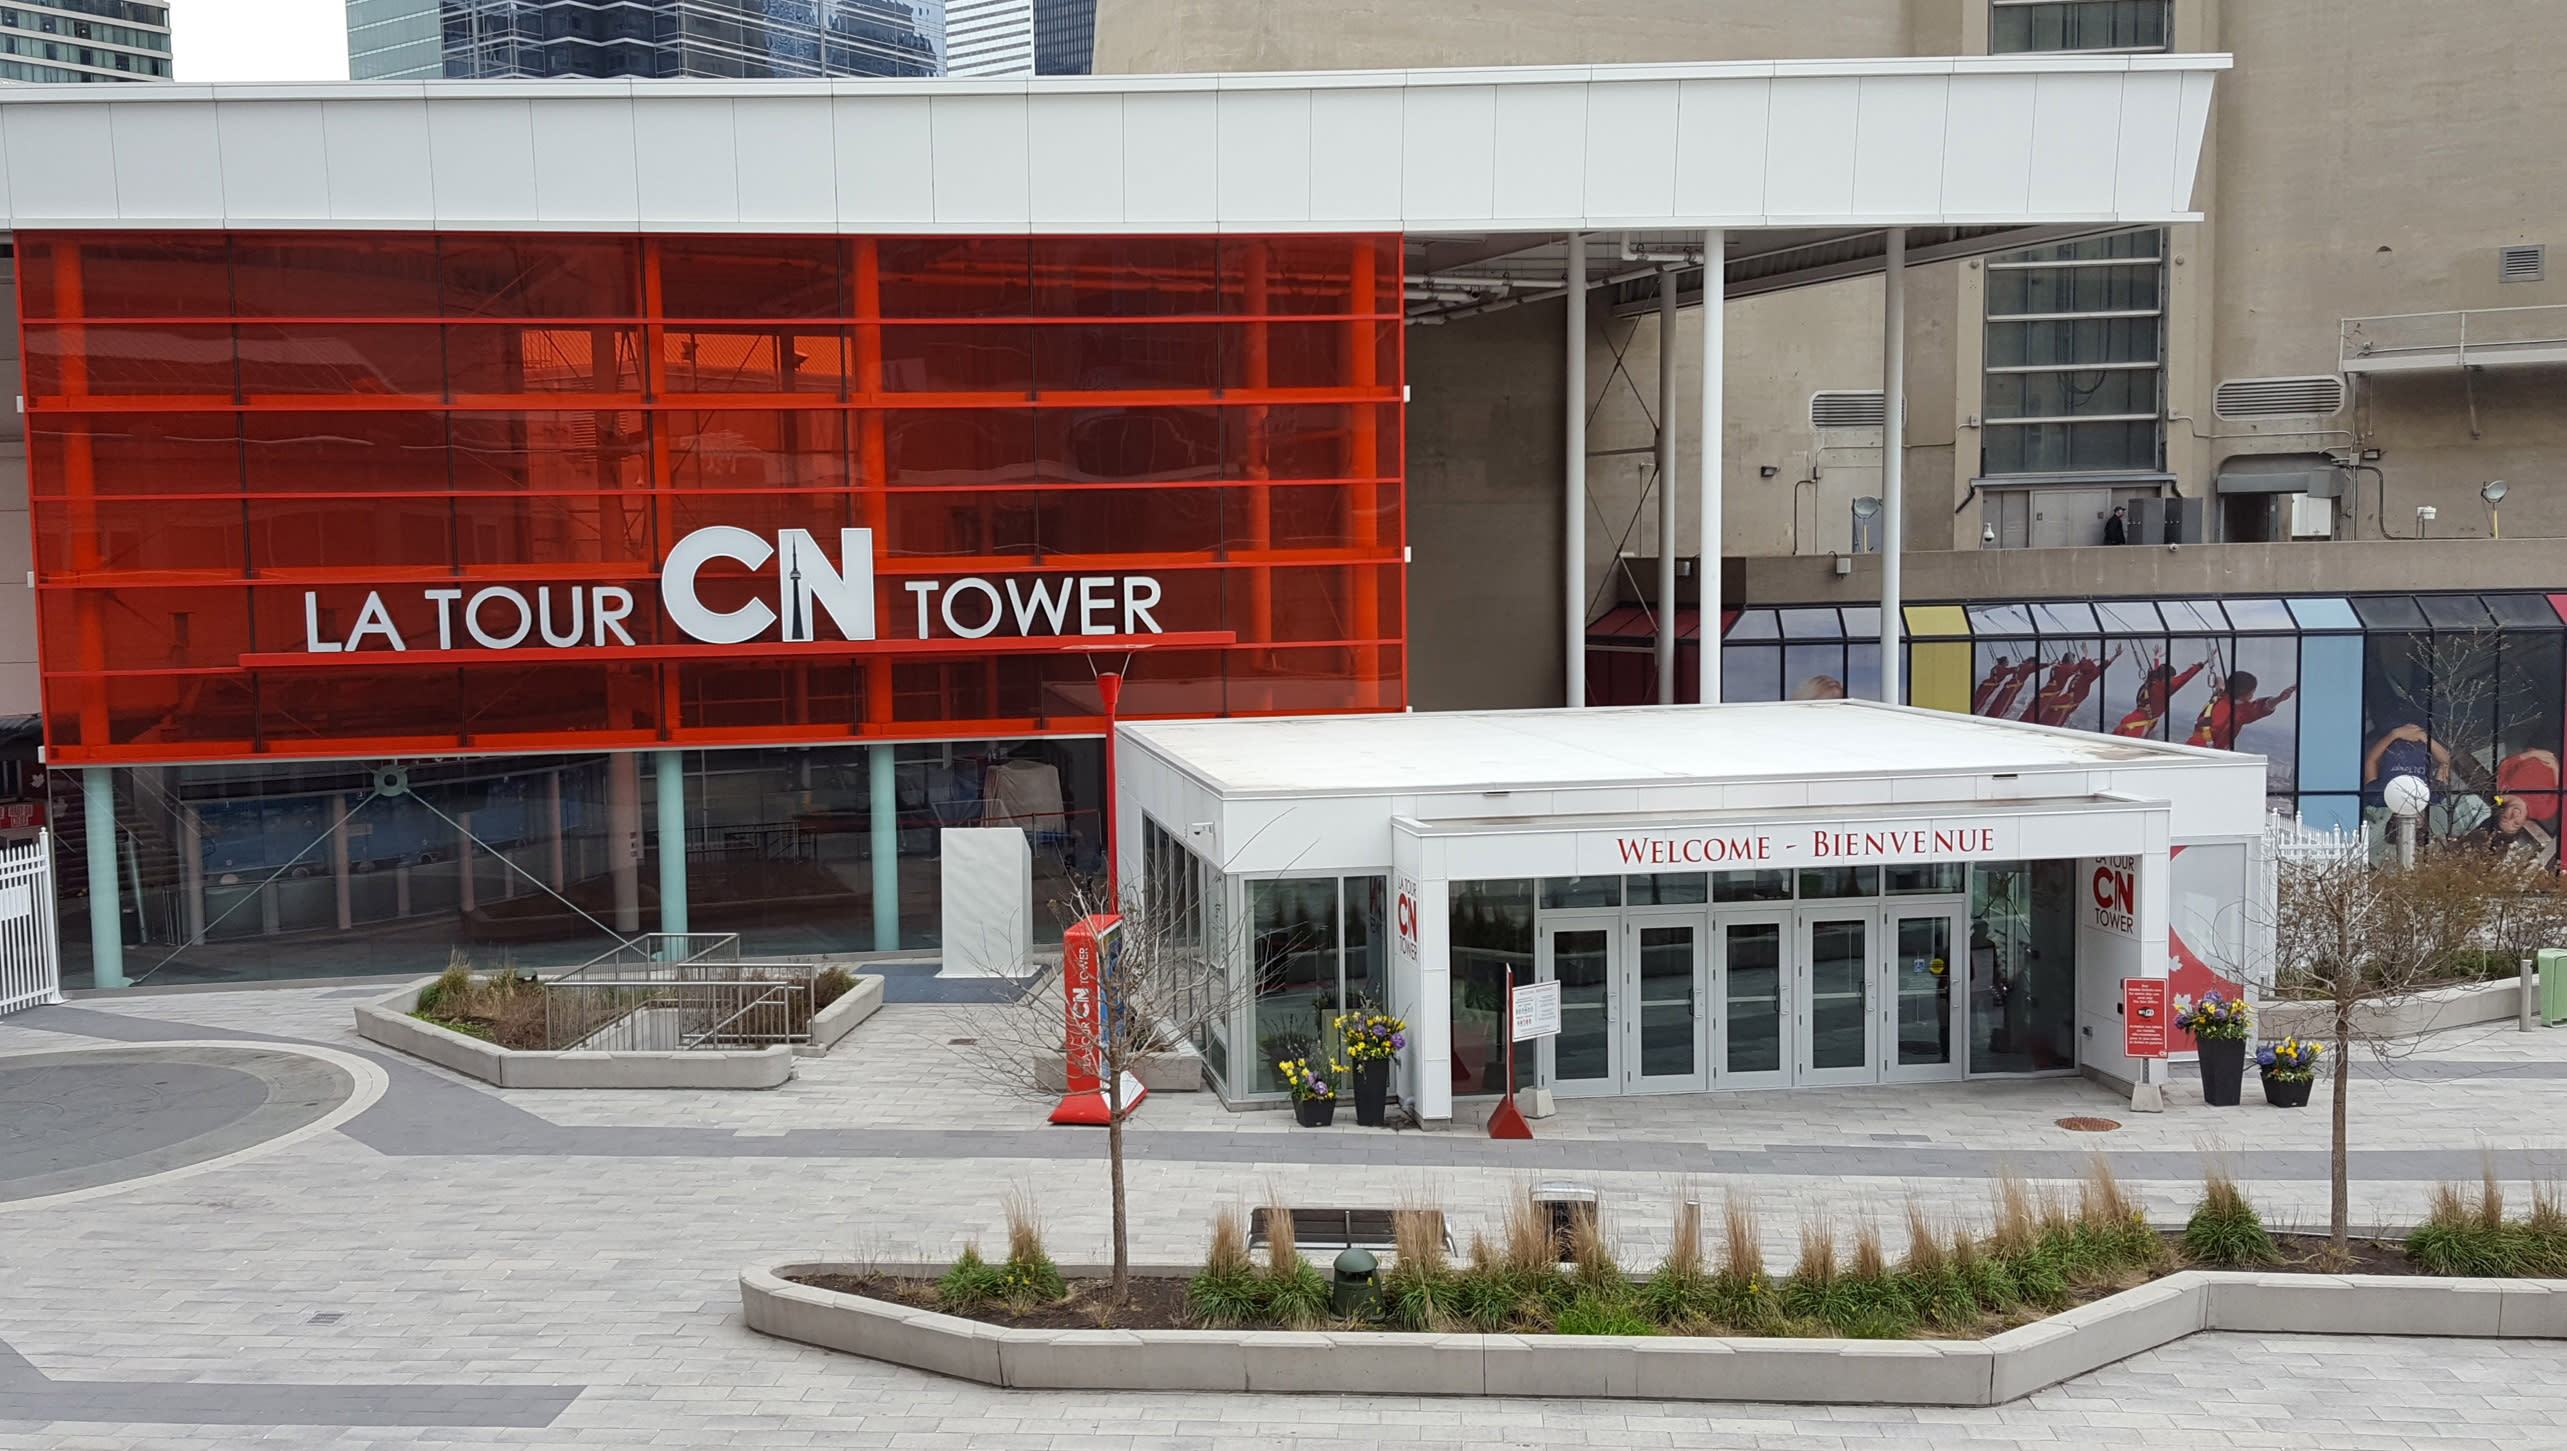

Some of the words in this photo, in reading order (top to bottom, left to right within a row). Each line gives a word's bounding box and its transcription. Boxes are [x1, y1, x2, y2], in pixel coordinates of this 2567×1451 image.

[305, 590, 406, 652] LA
[424, 585, 636, 650] TOUR
[661, 525, 876, 644] CN
[905, 576, 1163, 640] TOWER
[1616, 836, 1770, 864] WELCOME
[1813, 828, 1994, 857] BIENVENUE
[2093, 866, 2134, 915] CN
[1398, 892, 1418, 943] CN
[2095, 907, 2133, 935] TOWER
[1399, 935, 1418, 962] TOWER
[1072, 987, 1090, 1019] CN
